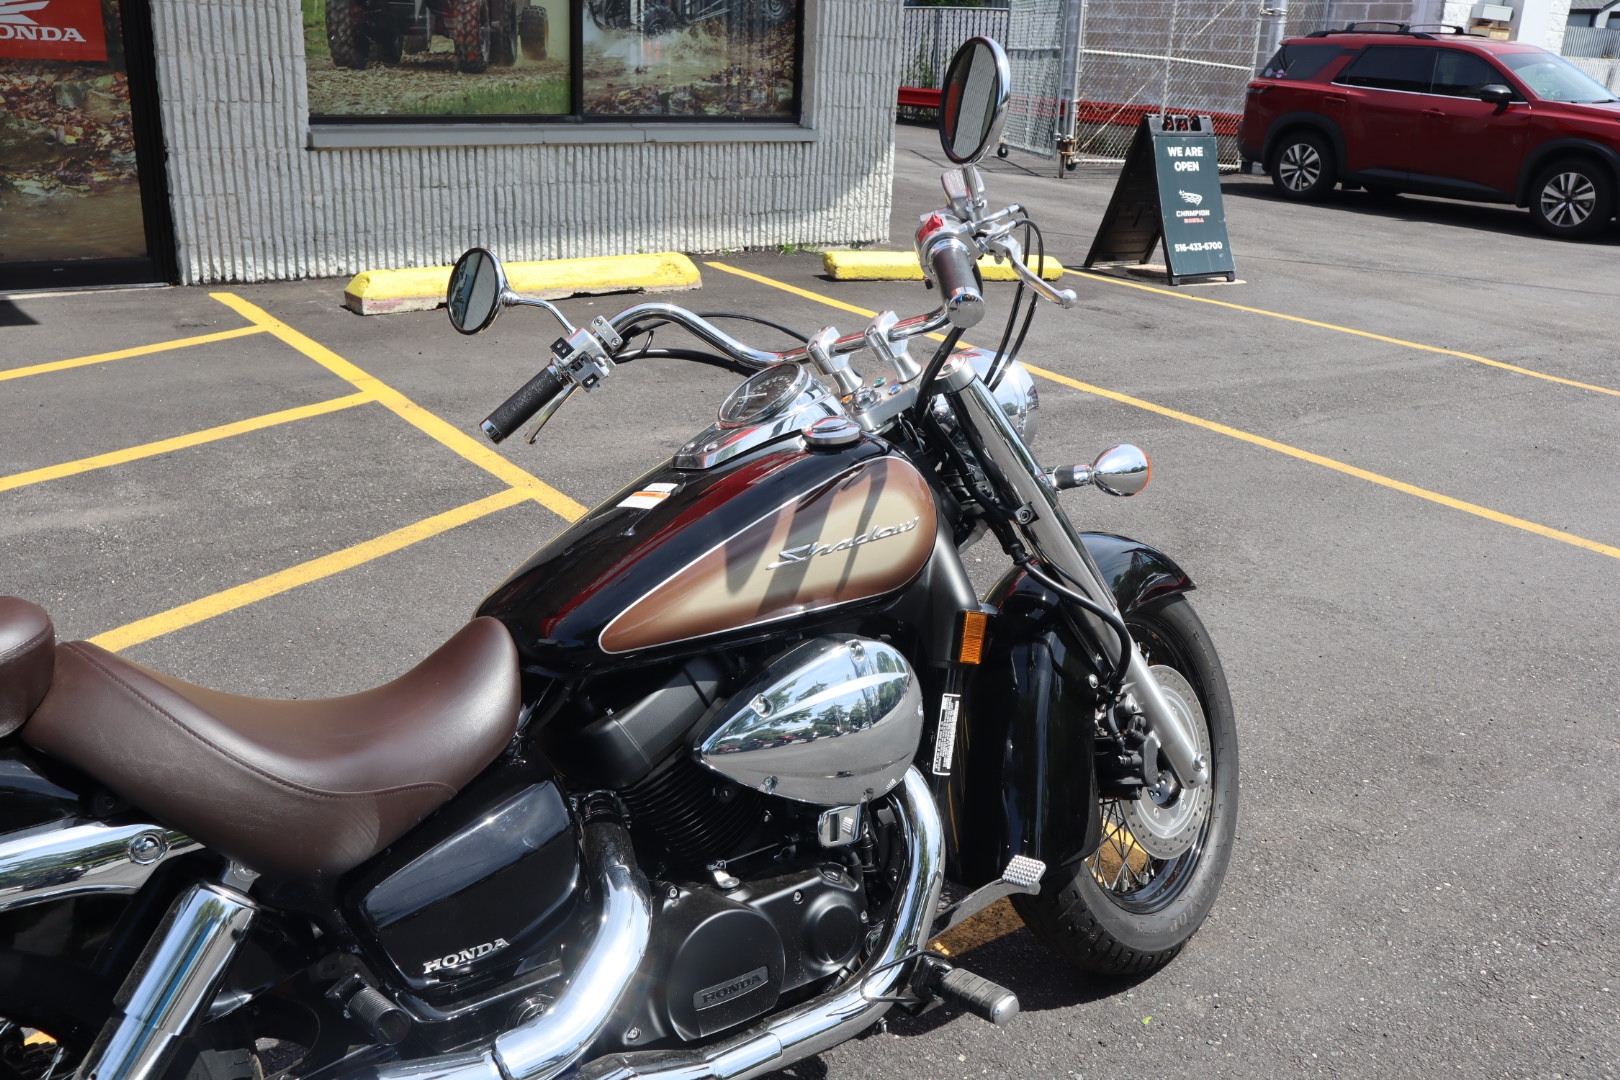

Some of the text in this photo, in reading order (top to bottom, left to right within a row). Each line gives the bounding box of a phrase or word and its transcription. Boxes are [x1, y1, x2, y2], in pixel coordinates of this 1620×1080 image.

[1167, 146, 1204, 157] WE ARE
[1174, 161, 1200, 172] OPEN
[1175, 209, 1210, 217] CHAMPION
[1174, 241, 1223, 252] 516-433-6700
[766, 516, 920, 570] Shadow
[422, 937, 511, 975] HONDA
[701, 974, 762, 1004] HONDA
